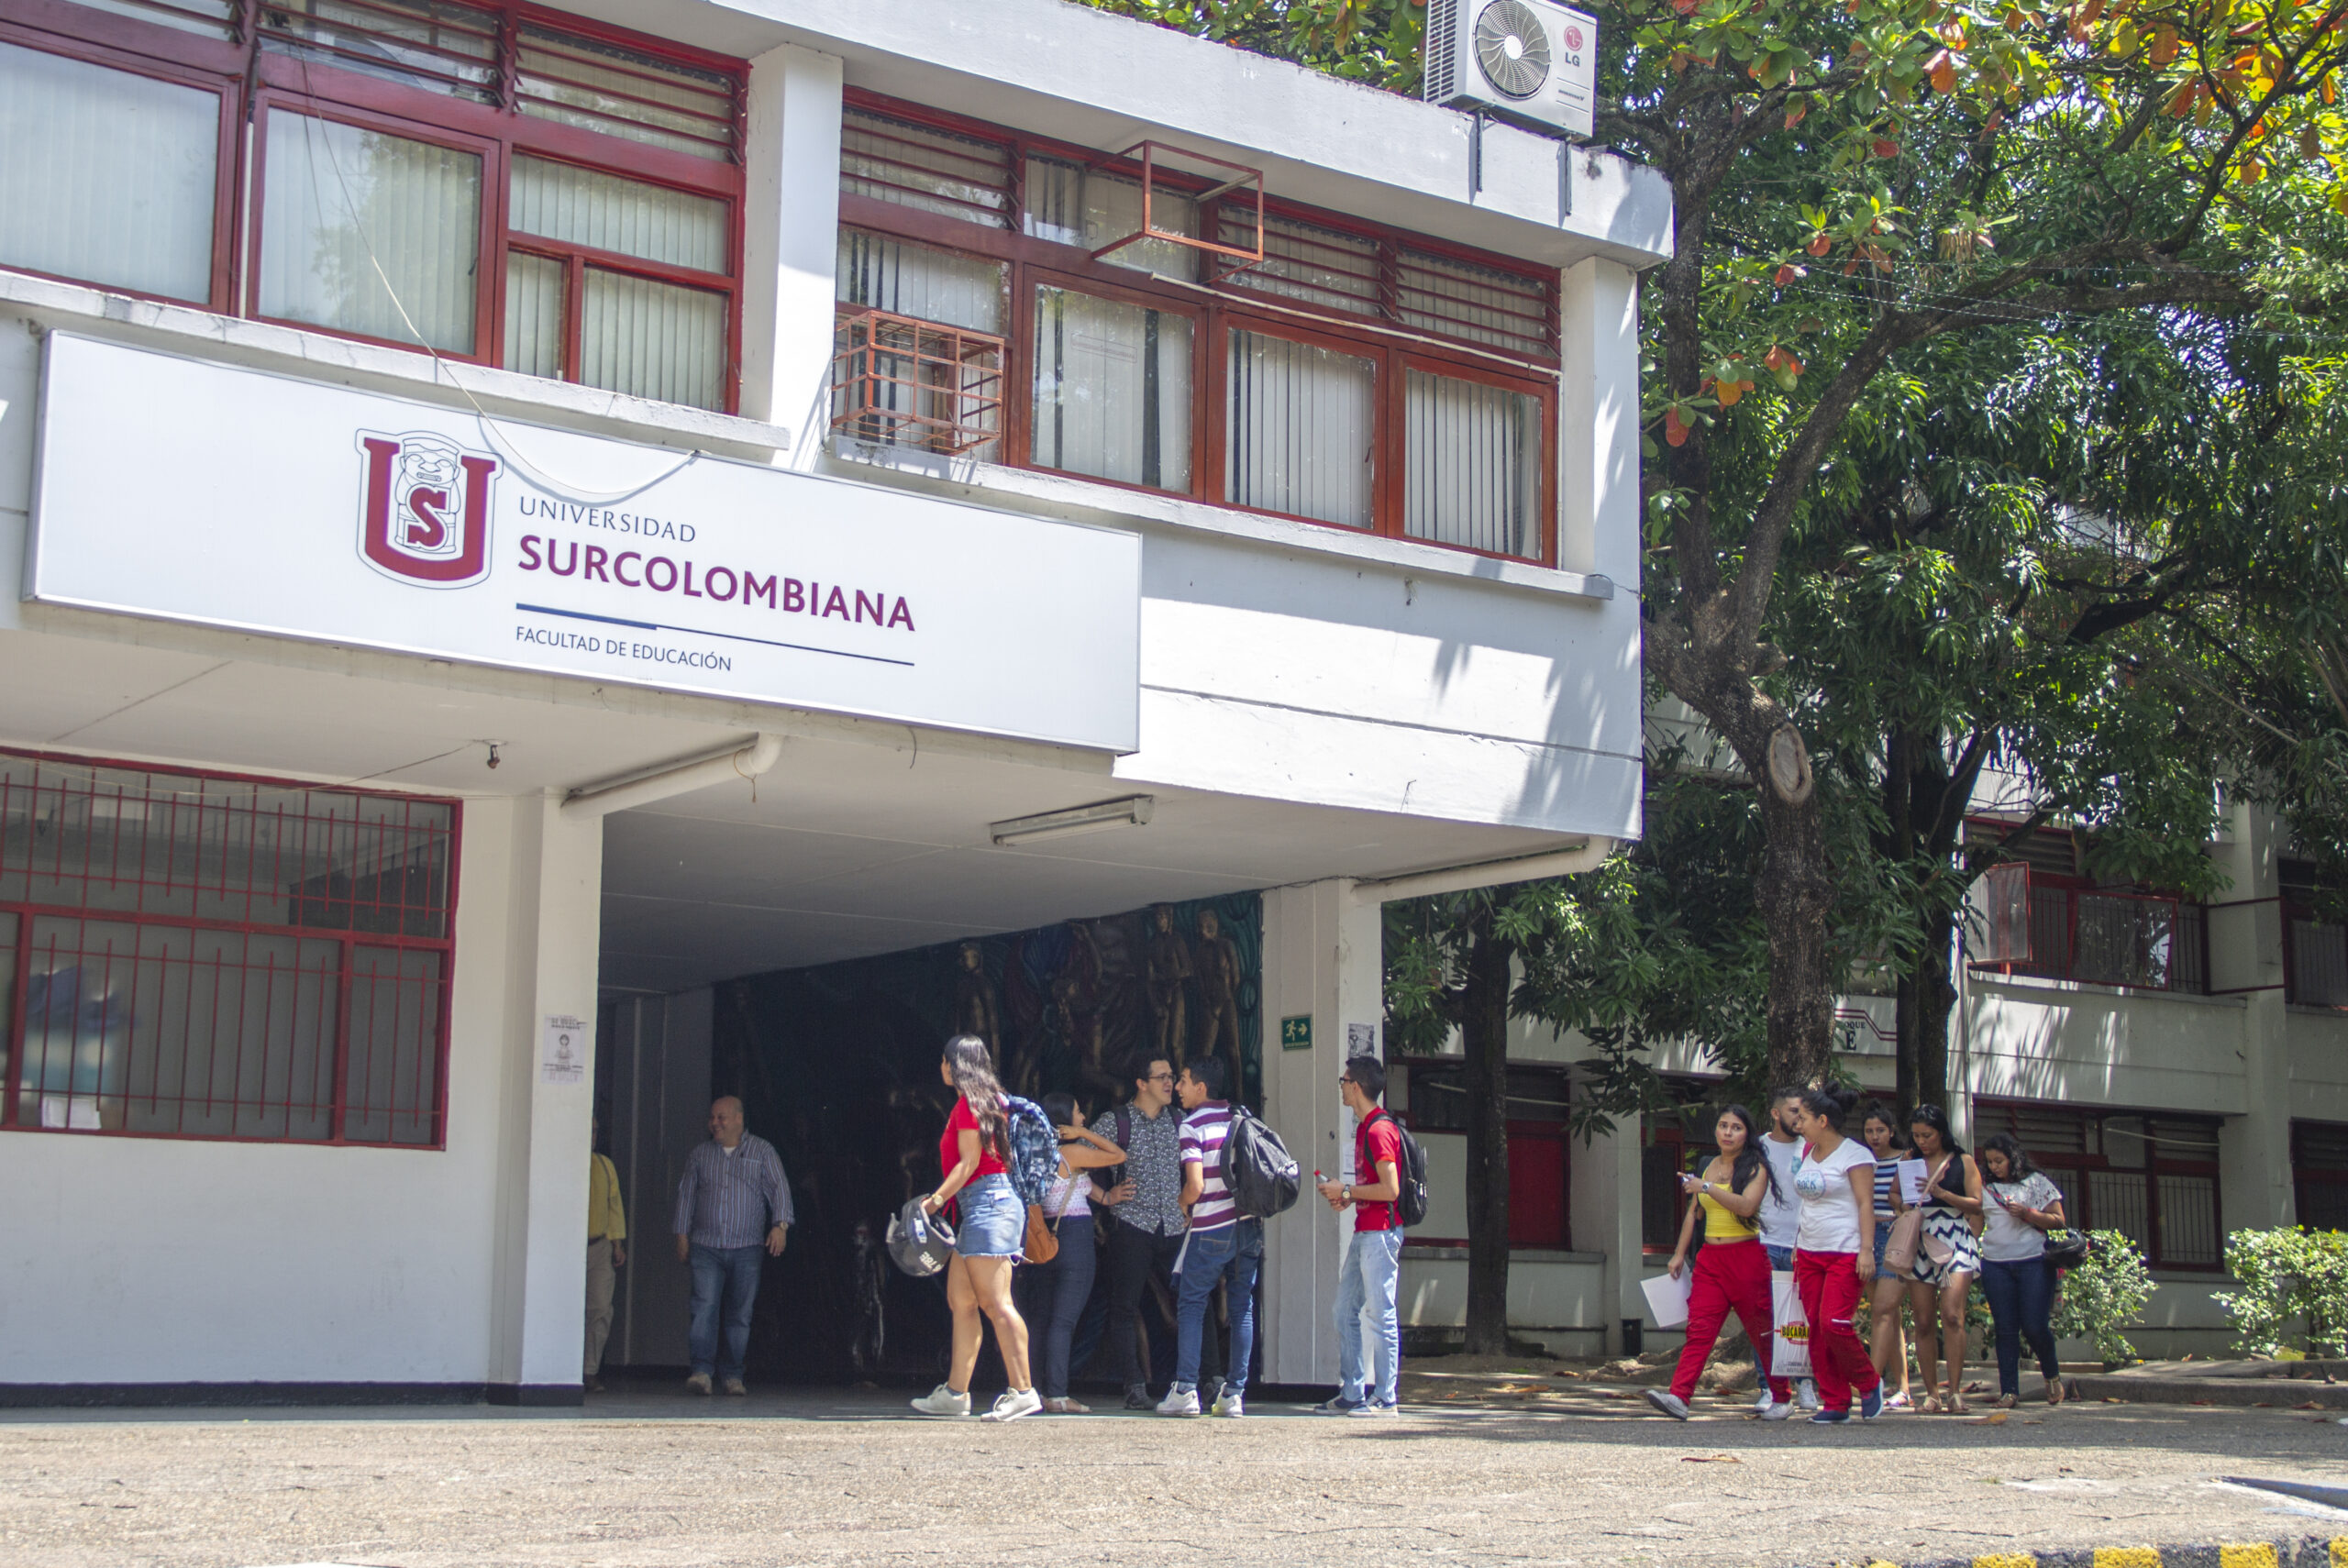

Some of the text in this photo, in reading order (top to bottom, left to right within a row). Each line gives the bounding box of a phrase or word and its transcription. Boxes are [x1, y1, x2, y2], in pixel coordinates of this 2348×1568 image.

[1565, 52, 1580, 67] LG
[520, 495, 696, 543] UNIVERSIDAD
[517, 535, 915, 632] SURCOLOMBIANA
[516, 625, 731, 671] FACULTAD DE EDUCACIÓN
[1846, 1031, 1856, 1051] E
